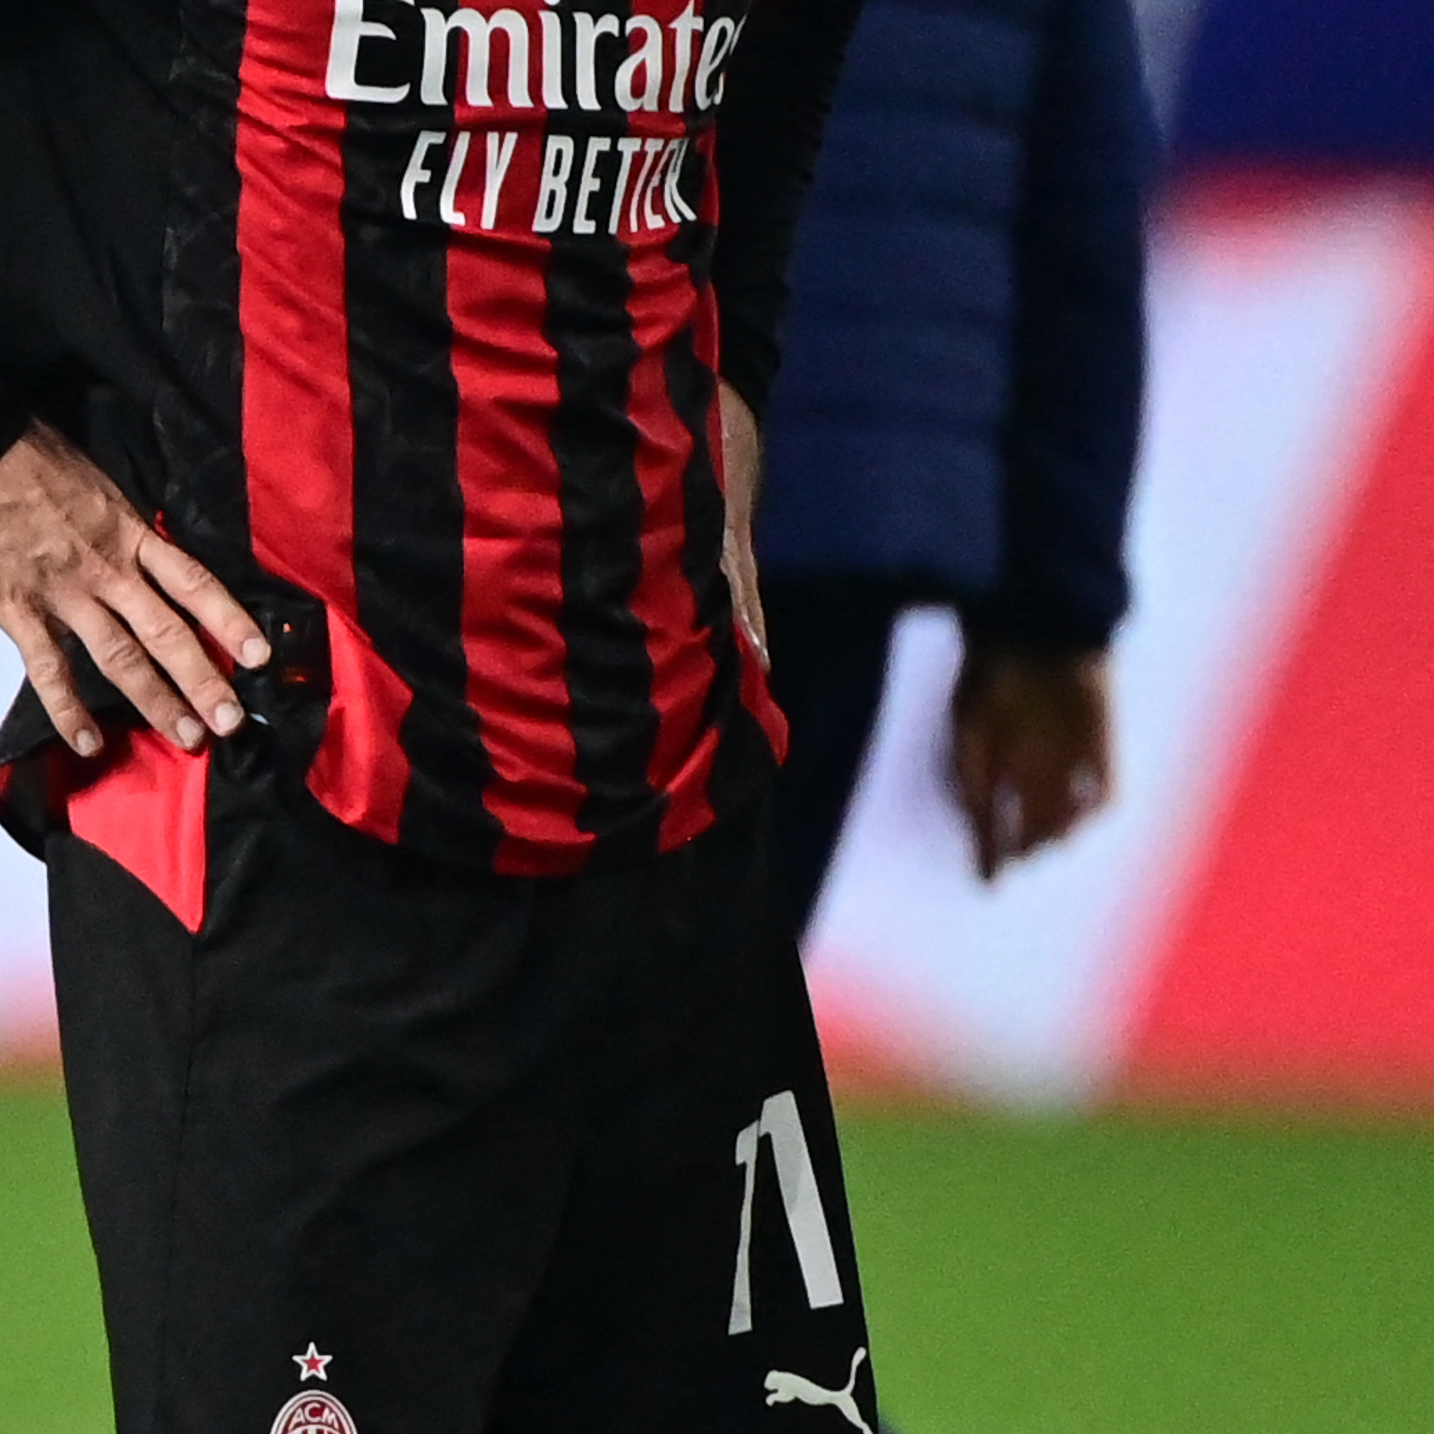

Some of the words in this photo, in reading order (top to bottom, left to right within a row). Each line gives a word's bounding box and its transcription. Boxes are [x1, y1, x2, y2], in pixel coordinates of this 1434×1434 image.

[400, 131, 519, 231] FLY
[727, 1089, 844, 1336] 11
[287, 1402, 340, 1432] ACM
